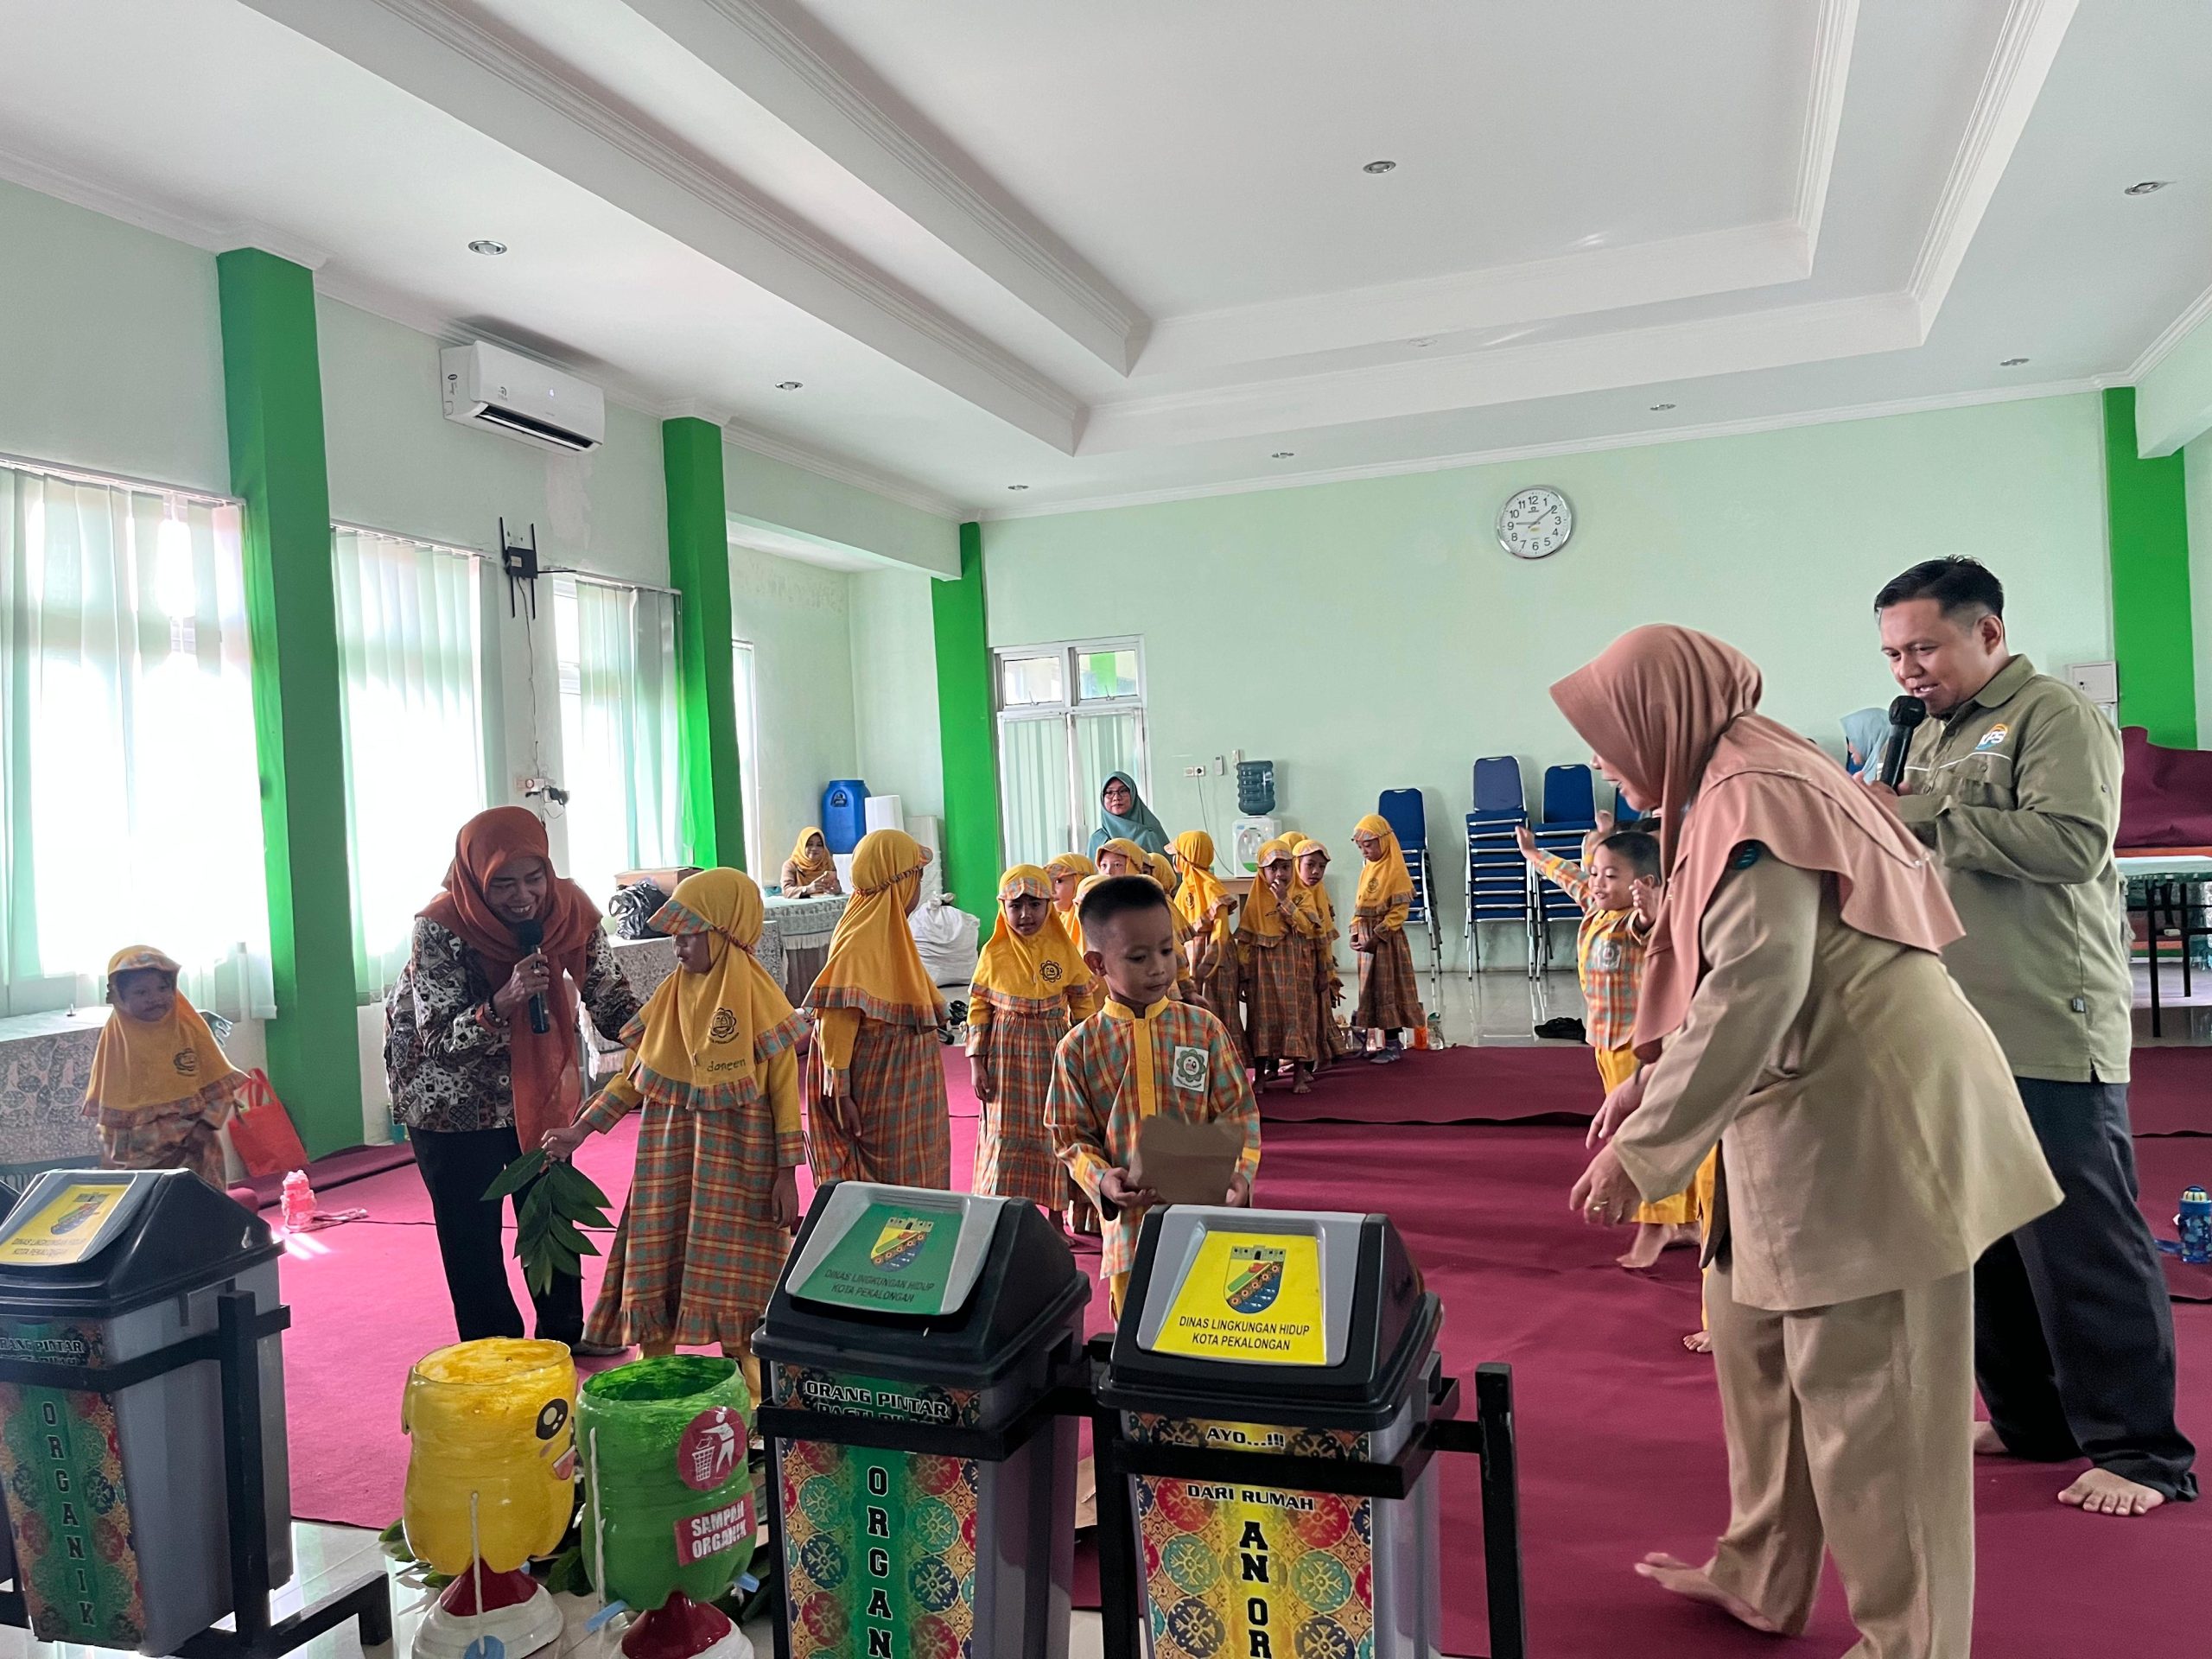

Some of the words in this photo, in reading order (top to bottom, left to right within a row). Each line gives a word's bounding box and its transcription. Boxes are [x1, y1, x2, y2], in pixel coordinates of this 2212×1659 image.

[1518, 500, 1526, 509] 11
[1529, 496, 1538, 505] 12
[1510, 510, 1519, 518] 10
[1551, 505, 1558, 514] 2
[1554, 516, 1561, 524] 3
[1507, 522, 1514, 531] 9
[1511, 532, 1518, 541] 8
[1521, 540, 1527, 549] 7
[1532, 542, 1539, 550] 6
[1544, 537, 1551, 546] 5
[825, 1269, 851, 1280] DINAS
[852, 1274, 906, 1288] LINGKUNGAN
[907, 1281, 935, 1291] HIDUP
[831, 1283, 854, 1294] KOTA
[855, 1287, 914, 1302] PEKALONGAN
[1179, 1316, 1209, 1328] DINAS
[1211, 1319, 1276, 1333] LINGKUNGAN
[1279, 1325, 1310, 1336] HIDUP
[1192, 1333, 1218, 1345] KOTA
[1221, 1336, 1290, 1350] PEKALONGAN
[805, 1380, 872, 1404] ORANG
[876, 1392, 950, 1418] PINTAR
[1186, 1484, 1234, 1501] DARI
[1242, 1490, 1314, 1510] RUMAH
[41, 1401, 97, 1627] ORGANIK
[691, 1500, 744, 1536] SAMPAH
[867, 1465, 893, 1659] ORGAN
